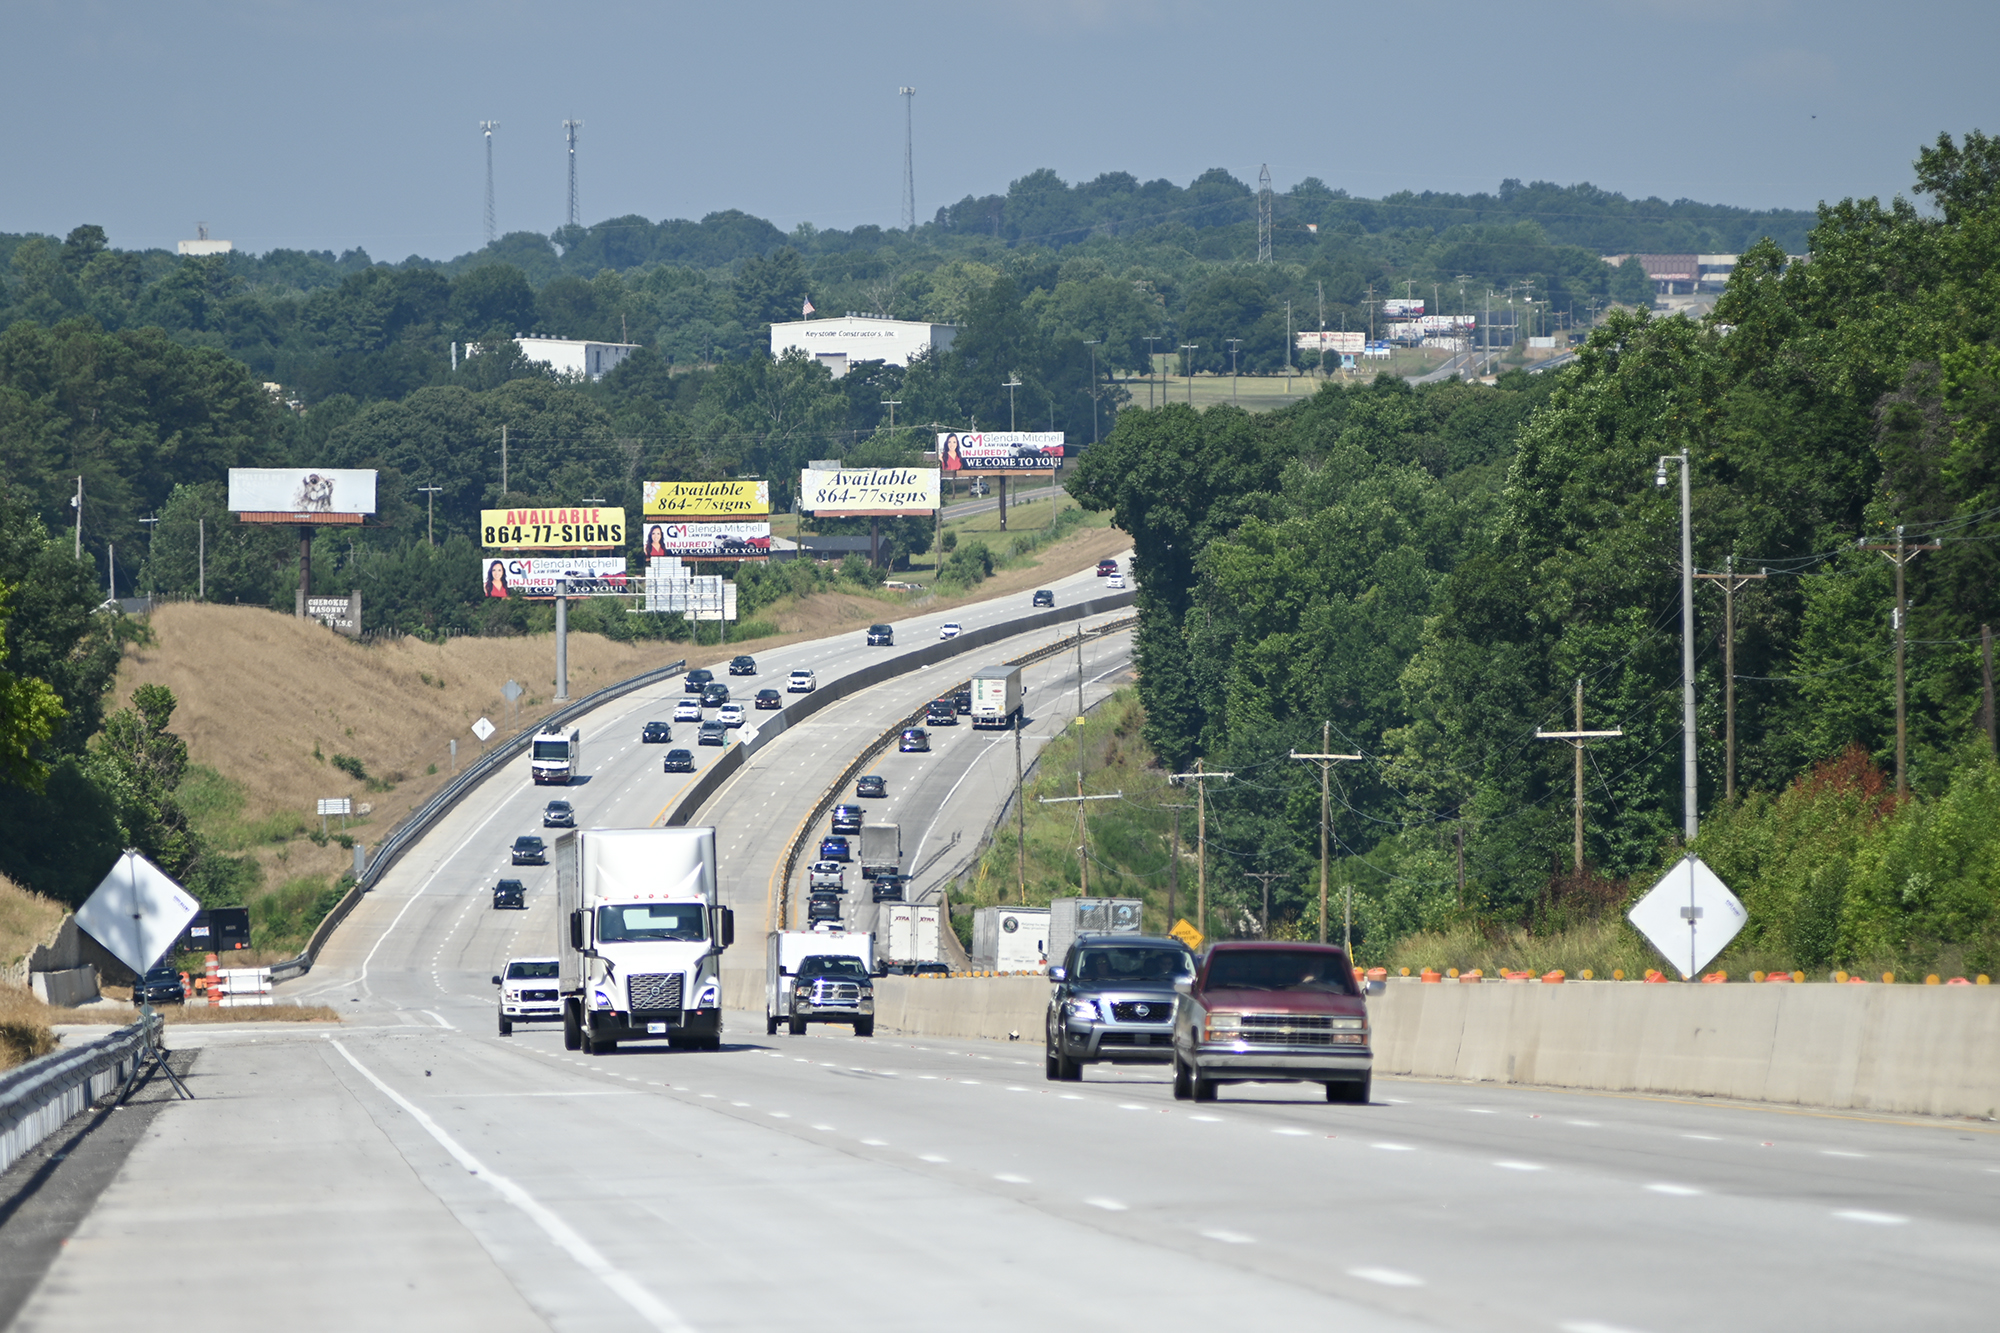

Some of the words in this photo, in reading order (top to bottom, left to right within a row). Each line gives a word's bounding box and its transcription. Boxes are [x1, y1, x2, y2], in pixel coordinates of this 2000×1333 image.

[983, 434, 1018, 442] Glenda
[1022, 433, 1062, 442] Mitchell
[966, 458, 982, 466] WE
[984, 458, 1016, 466] COME
[1018, 458, 1033, 466] TO
[828, 470, 917, 486] Available
[668, 483, 744, 496] Available
[816, 488, 927, 506] 864-77signs
[658, 498, 752, 512] 864-77signs
[506, 509, 600, 525] AVAILABLE
[485, 524, 622, 543] 864-77-SIGNS
[688, 525, 721, 533] Glenda
[725, 524, 762, 532] Mitchell
[532, 560, 571, 568] Glenda
[574, 559, 617, 568] Mitchell
